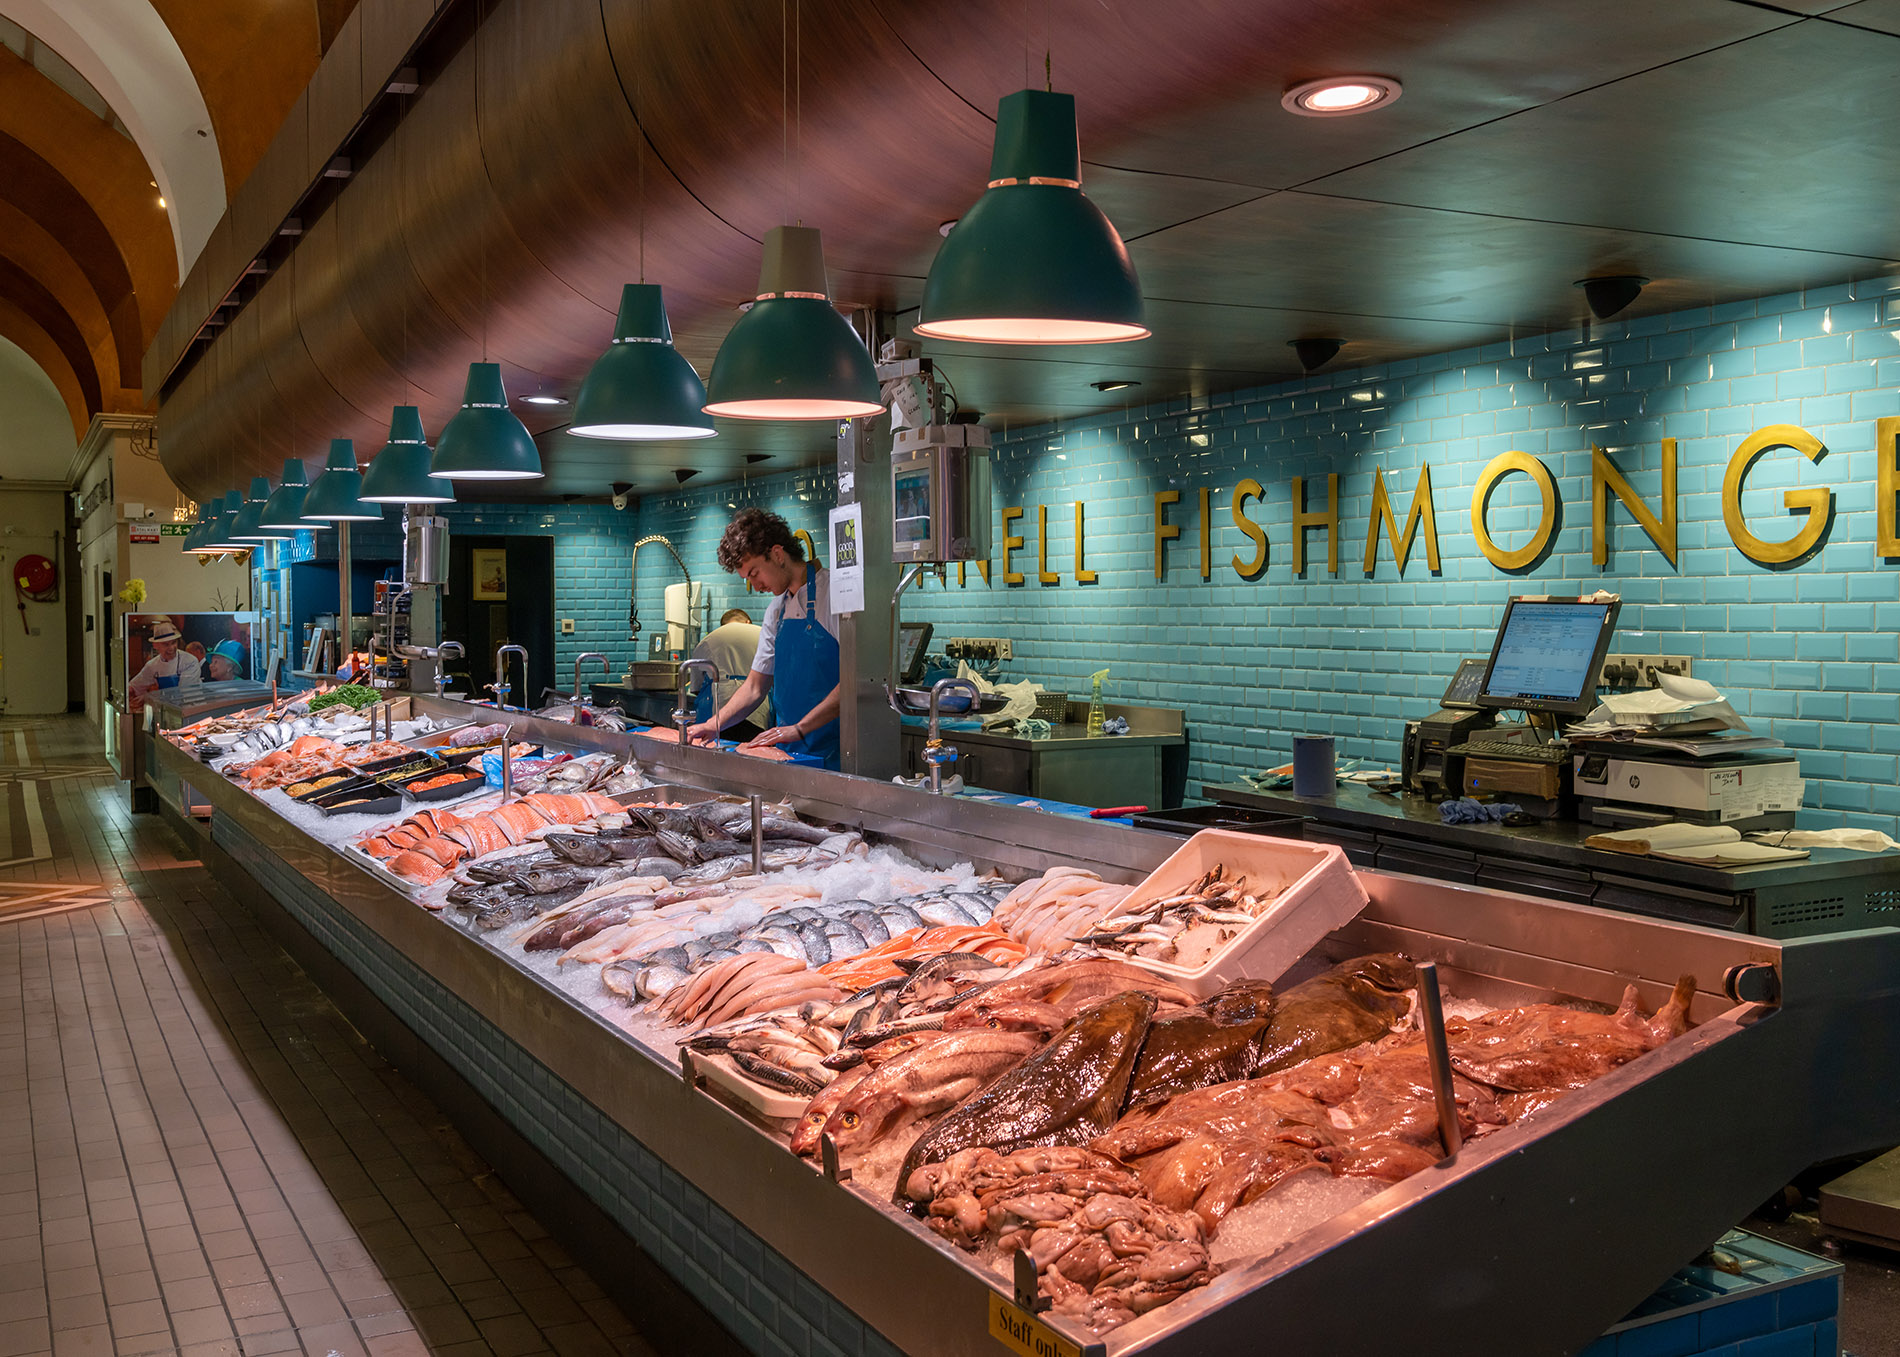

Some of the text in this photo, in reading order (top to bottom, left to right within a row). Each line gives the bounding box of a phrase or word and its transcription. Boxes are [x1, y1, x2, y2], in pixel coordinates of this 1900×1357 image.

[837, 548, 856, 562] FOOD
[838, 541, 853, 553] GOOD
[1000, 1306, 1033, 1347] Staff
[1035, 1338, 1066, 1357] onl
